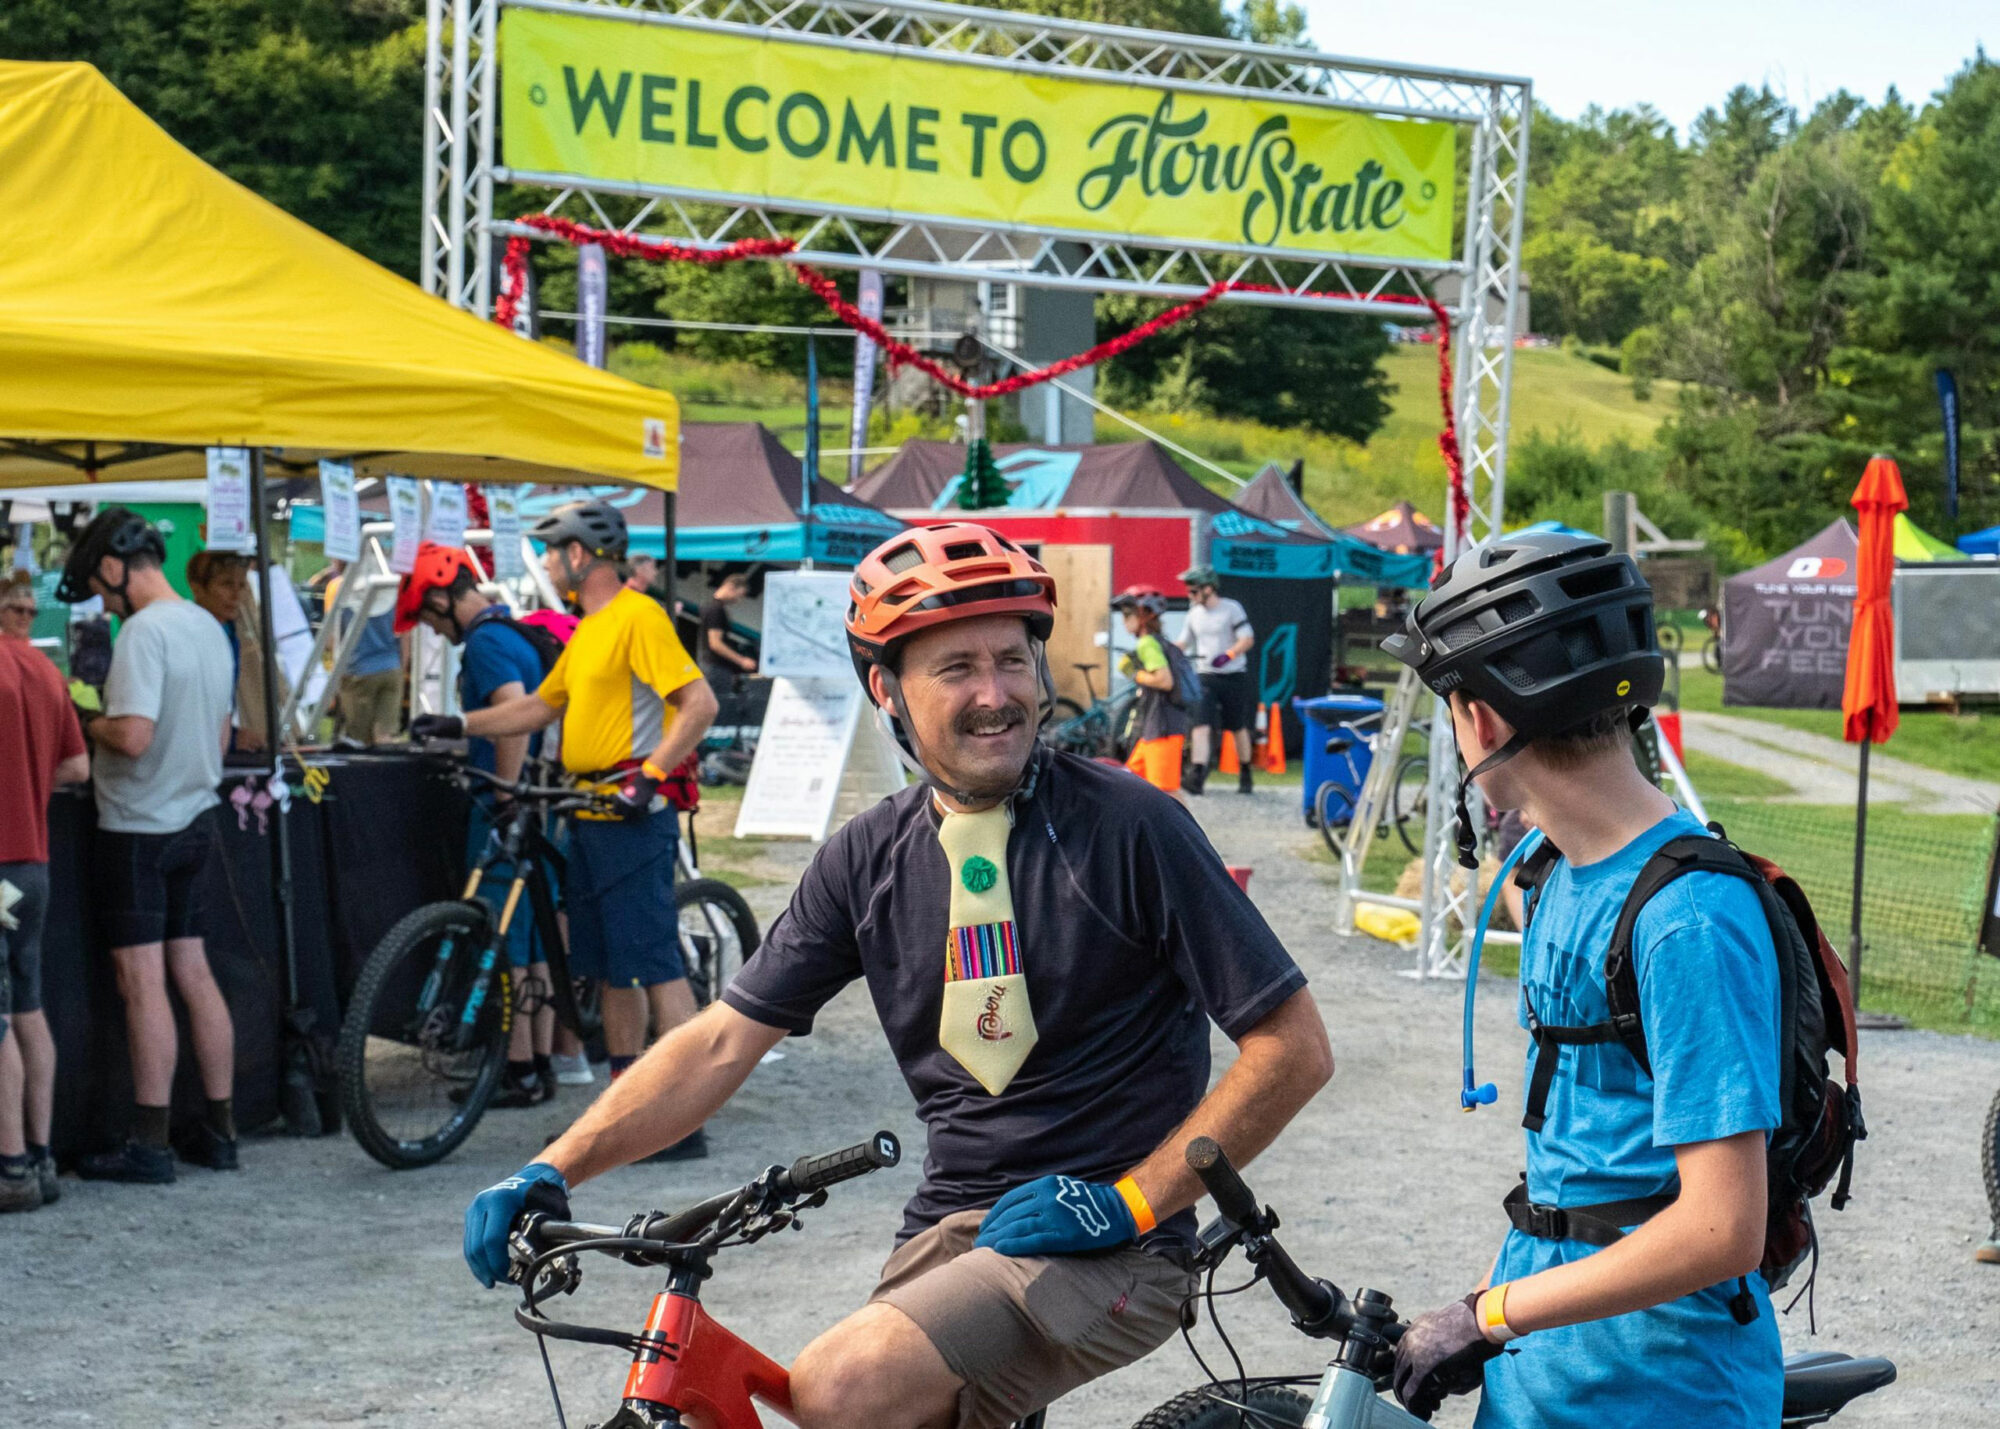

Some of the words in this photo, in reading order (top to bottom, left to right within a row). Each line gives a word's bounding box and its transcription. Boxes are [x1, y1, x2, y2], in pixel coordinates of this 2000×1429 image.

[562, 65, 940, 174] WELCOME
[961, 113, 1047, 184] TO
[1242, 115, 1404, 247] State
[1763, 599, 1853, 624] TUN
[1431, 669, 1464, 692] SMITH
[1761, 648, 1843, 674] FEE
[976, 984, 1013, 1041] Peru
